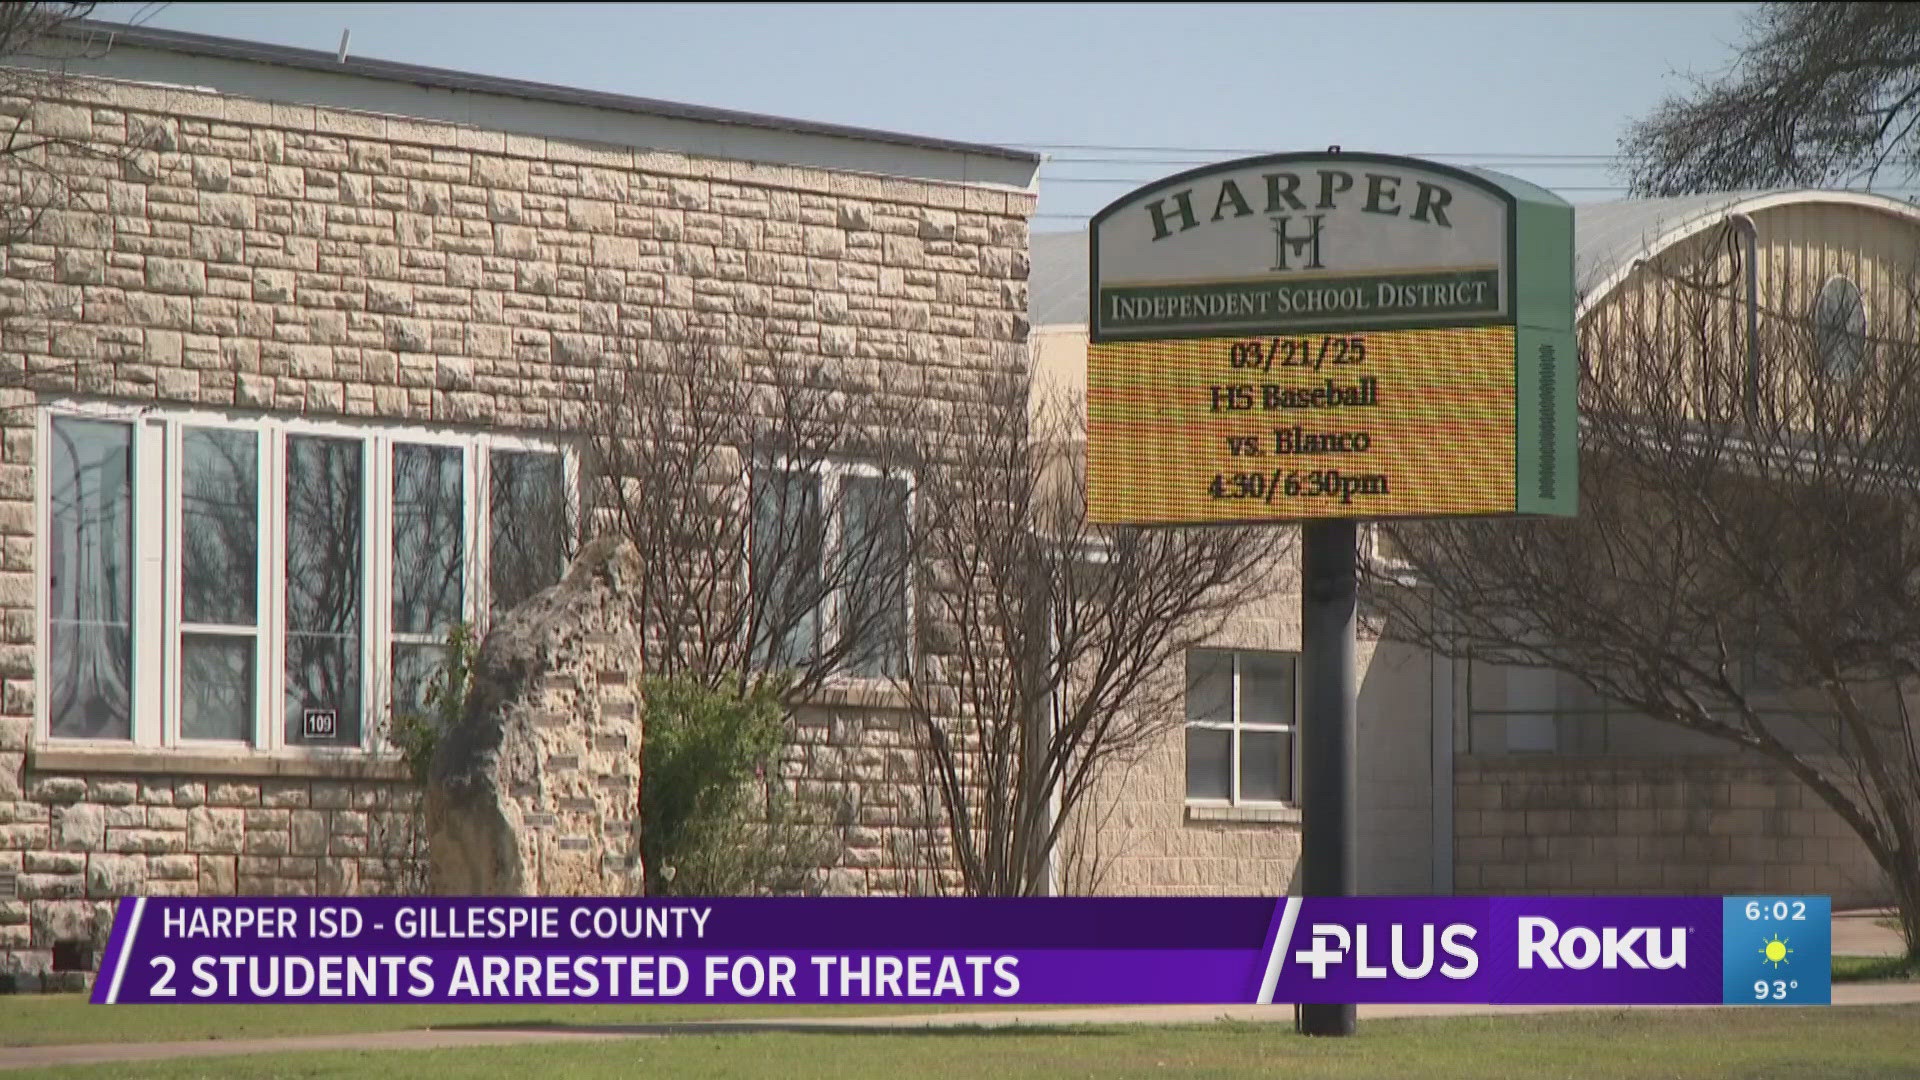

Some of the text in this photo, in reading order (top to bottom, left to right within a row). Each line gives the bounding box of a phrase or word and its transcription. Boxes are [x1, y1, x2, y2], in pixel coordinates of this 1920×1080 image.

[1144, 169, 1454, 243] HARPER
[1110, 280, 1488, 321] INDEPENDENT SCHOOL DISTRICT
[1231, 337, 1367, 371] 03/21/25
[1210, 376, 1378, 413] HS Baseball
[1227, 427, 1372, 457] vs. Blanco
[1209, 468, 1391, 504] 4:30/6:30pm
[309, 714, 332, 732] 109
